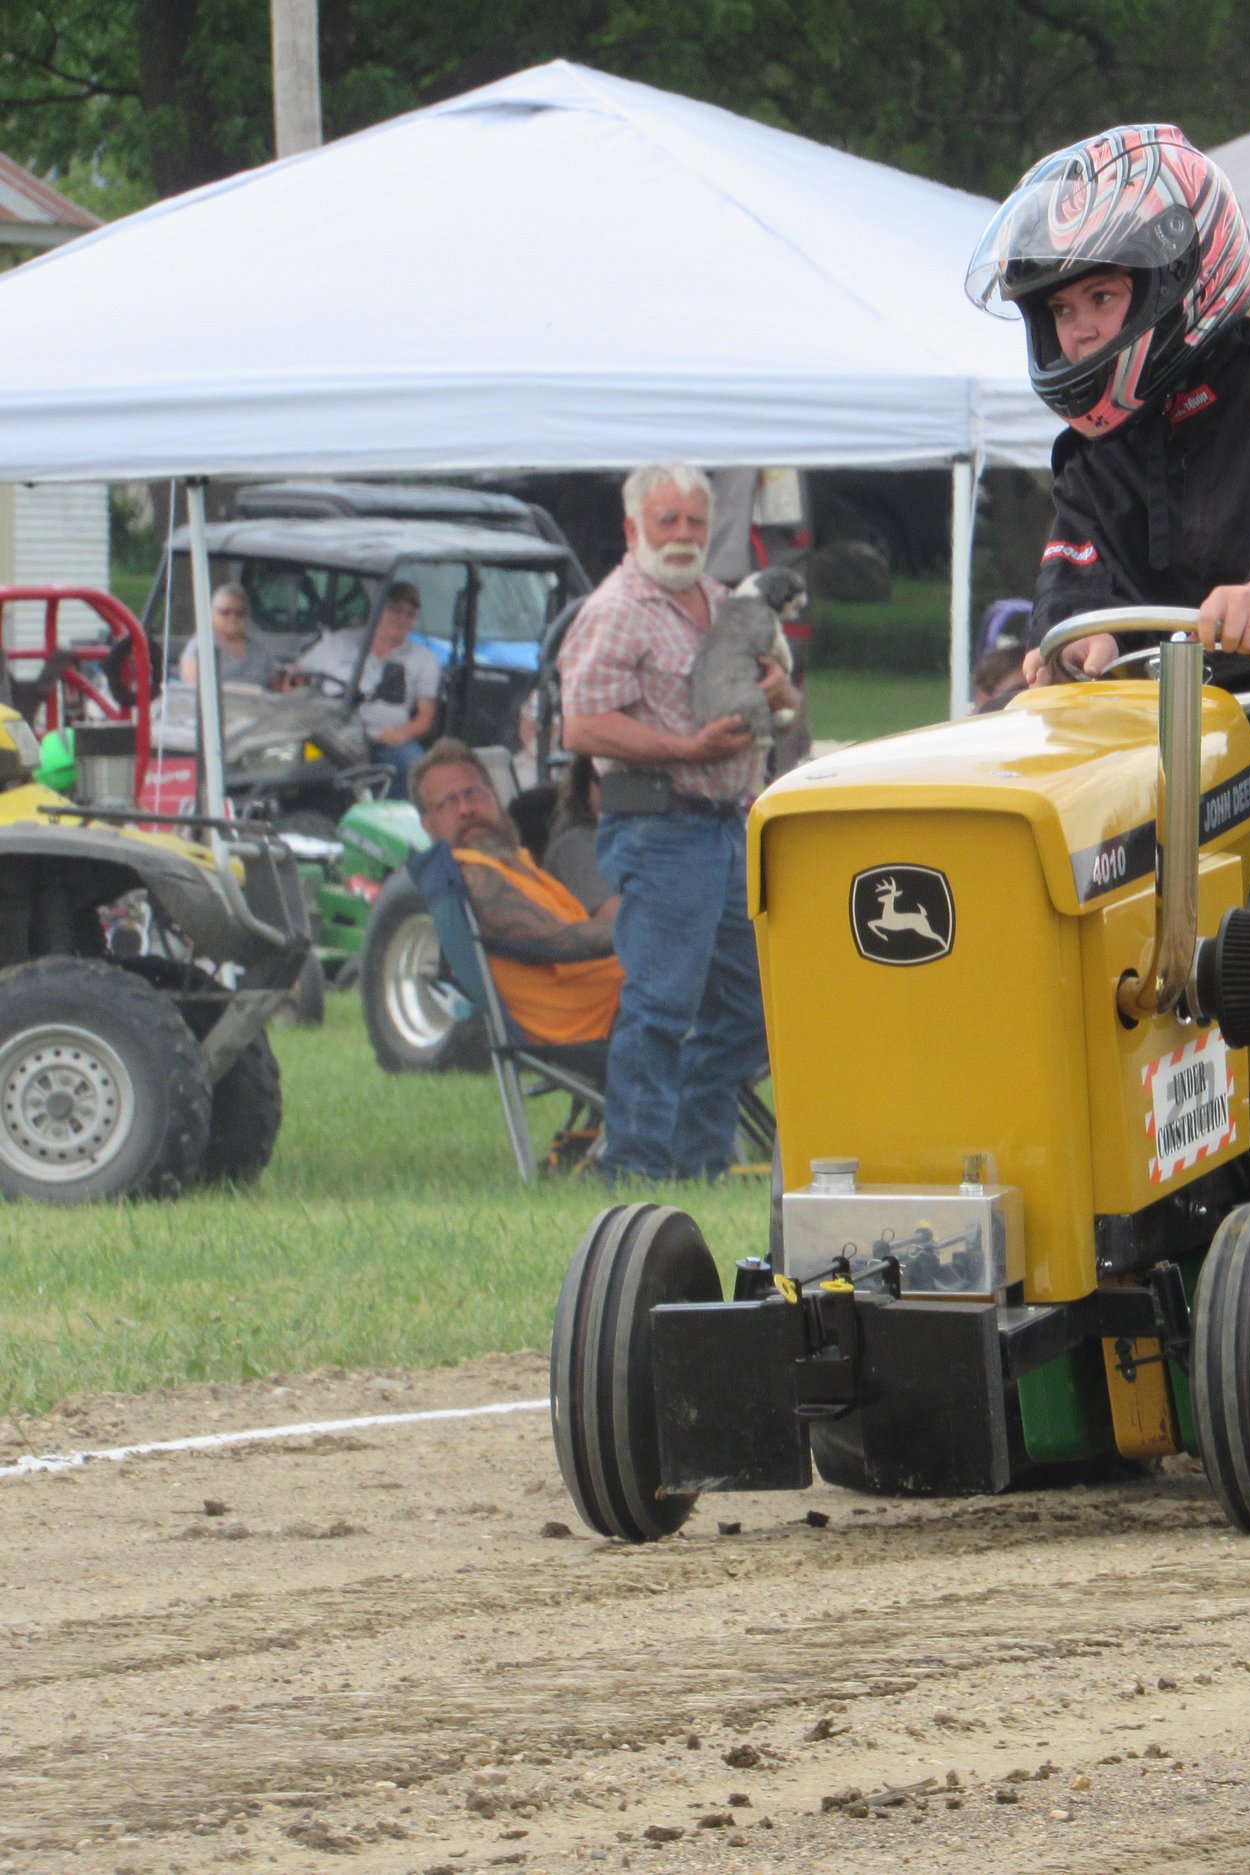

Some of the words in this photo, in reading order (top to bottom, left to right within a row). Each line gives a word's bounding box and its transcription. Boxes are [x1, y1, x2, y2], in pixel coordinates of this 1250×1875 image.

[1203, 789, 1232, 833] JOHN
[1092, 846, 1127, 886] 4010
[1173, 1060, 1207, 1106] UNDER
[1157, 1092, 1227, 1160] CONSTRUCTION
